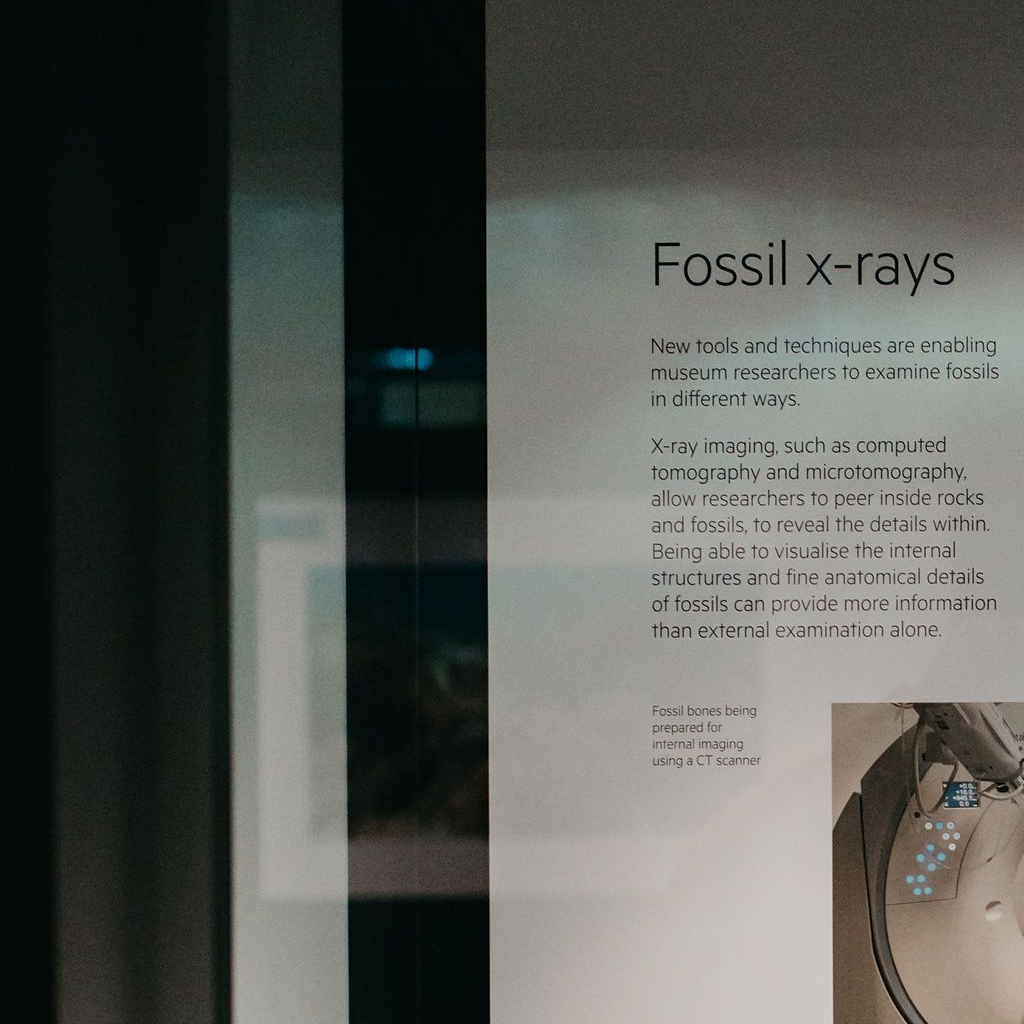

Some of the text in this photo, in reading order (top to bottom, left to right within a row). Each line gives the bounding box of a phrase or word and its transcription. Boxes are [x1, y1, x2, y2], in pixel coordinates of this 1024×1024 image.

[654, 239, 955, 297] Fossil x-rays
[651, 335, 997, 358] New tools and techniques are enabling
[651, 361, 1000, 381] museum researchers to examine fossils
[651, 389, 801, 411] in different ways.
[651, 435, 947, 458] X-ray imaging, such as computed
[651, 461, 967, 485] tomography and microtomography,
[651, 488, 985, 510] allow researchers to peer inside rocks
[651, 514, 990, 534] and fossils, to reveal the details within.
[652, 540, 956, 564] Being able to visualise the internal
[651, 567, 985, 587] structures and fine anatomical details
[651, 593, 997, 616] of fossils can provide more information
[651, 620, 942, 639] than external examination alone.
[652, 704, 757, 719] Fossil bones being
[652, 721, 723, 736] prepared for
[652, 738, 744, 753] internal imaging
[652, 754, 761, 769] using a CT scanner
